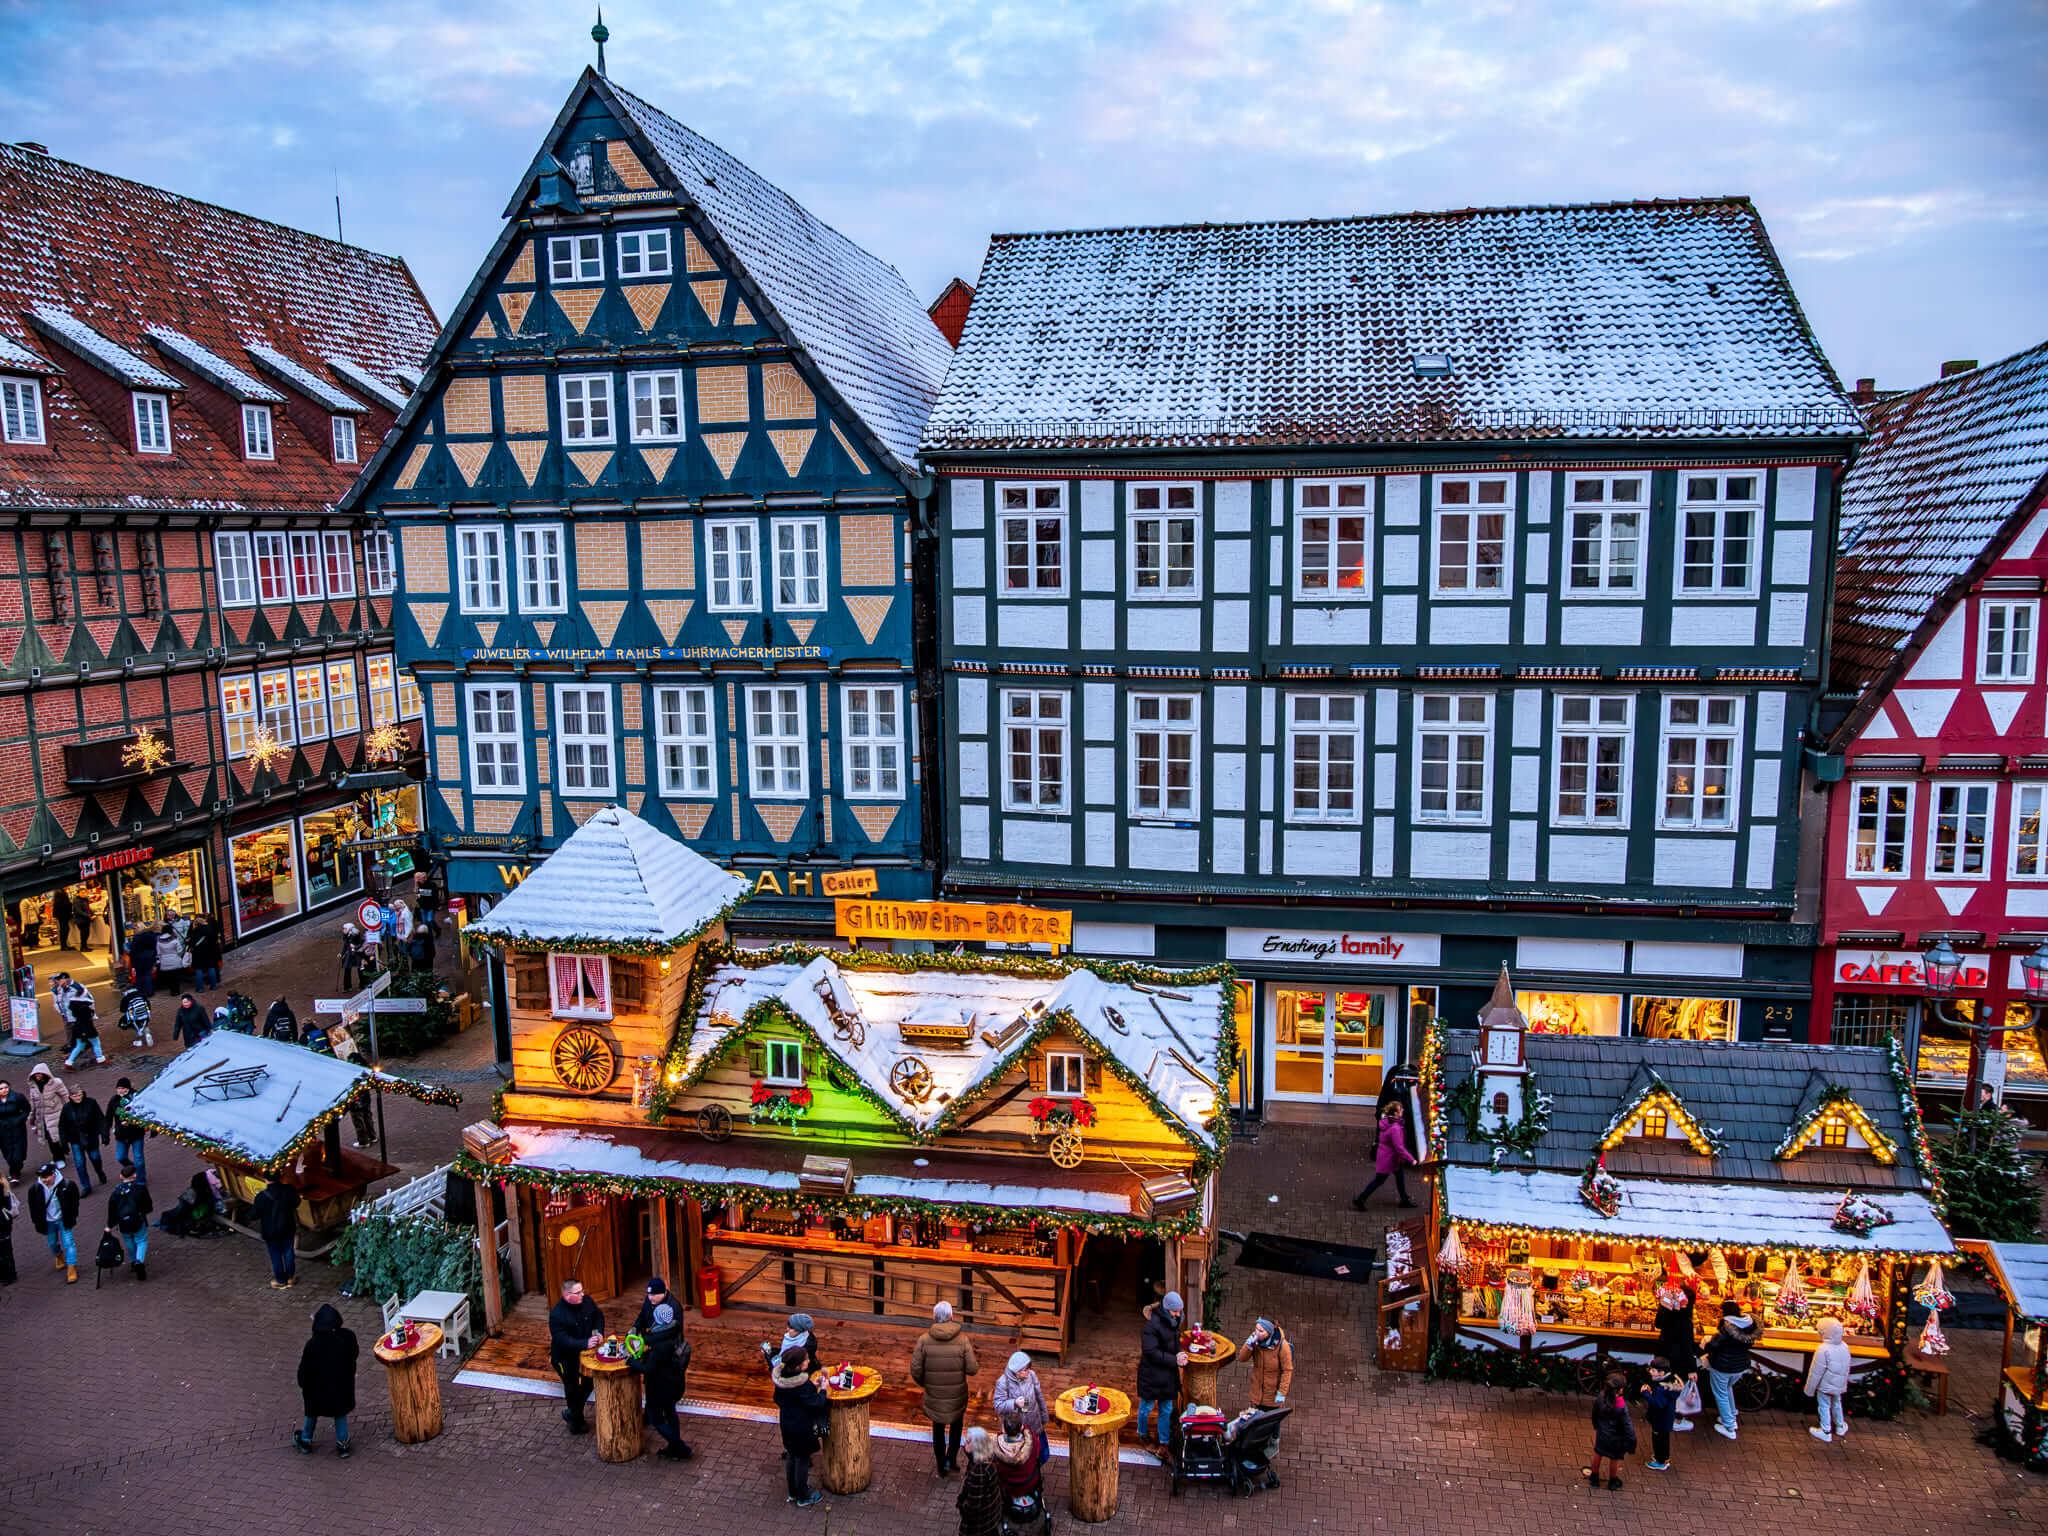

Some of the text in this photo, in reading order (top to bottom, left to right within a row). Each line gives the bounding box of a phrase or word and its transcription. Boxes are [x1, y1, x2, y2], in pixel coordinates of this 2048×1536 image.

[473, 645, 822, 660] JUWELIER WILHELM RAHLS UHRMACHERMEISTER
[98, 847, 154, 872] Müller
[825, 876, 873, 891] Celler
[1262, 934, 1405, 960] Ernsting's family
[1765, 1006, 1793, 1020] 2-3
